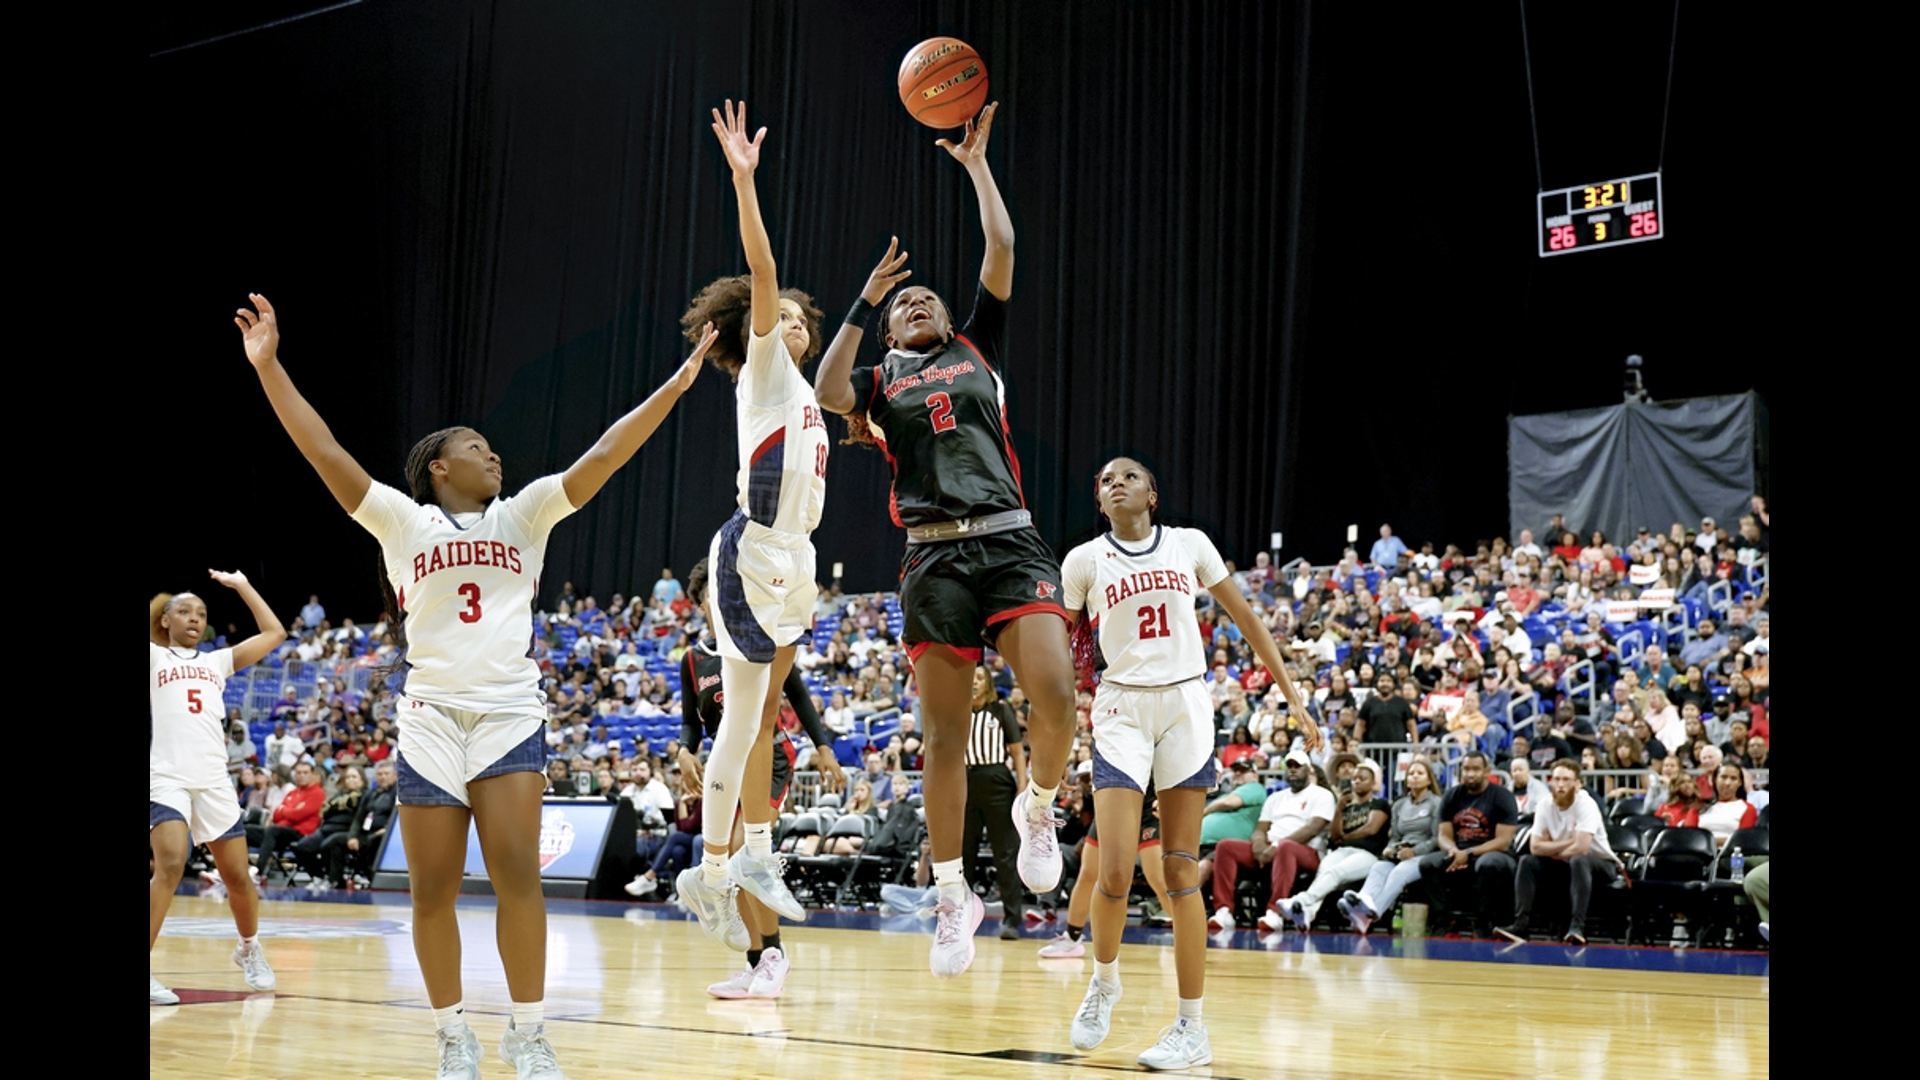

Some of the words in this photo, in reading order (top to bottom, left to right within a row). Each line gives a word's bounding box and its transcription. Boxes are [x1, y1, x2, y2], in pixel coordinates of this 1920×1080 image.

[1584, 182, 1627, 209] 3:21
[1550, 225, 1577, 250] 26
[1594, 222, 1606, 241] 3
[1630, 211, 1658, 238] 26
[920, 360, 976, 385] Wagner
[926, 391, 957, 434] 2
[413, 539, 523, 584] RAIDERS
[457, 581, 483, 624] 3
[1105, 570, 1190, 609] RAIDERS
[1137, 603, 1171, 640] 21
[157, 665, 222, 690] RAIDERS
[186, 688, 203, 714] 5
